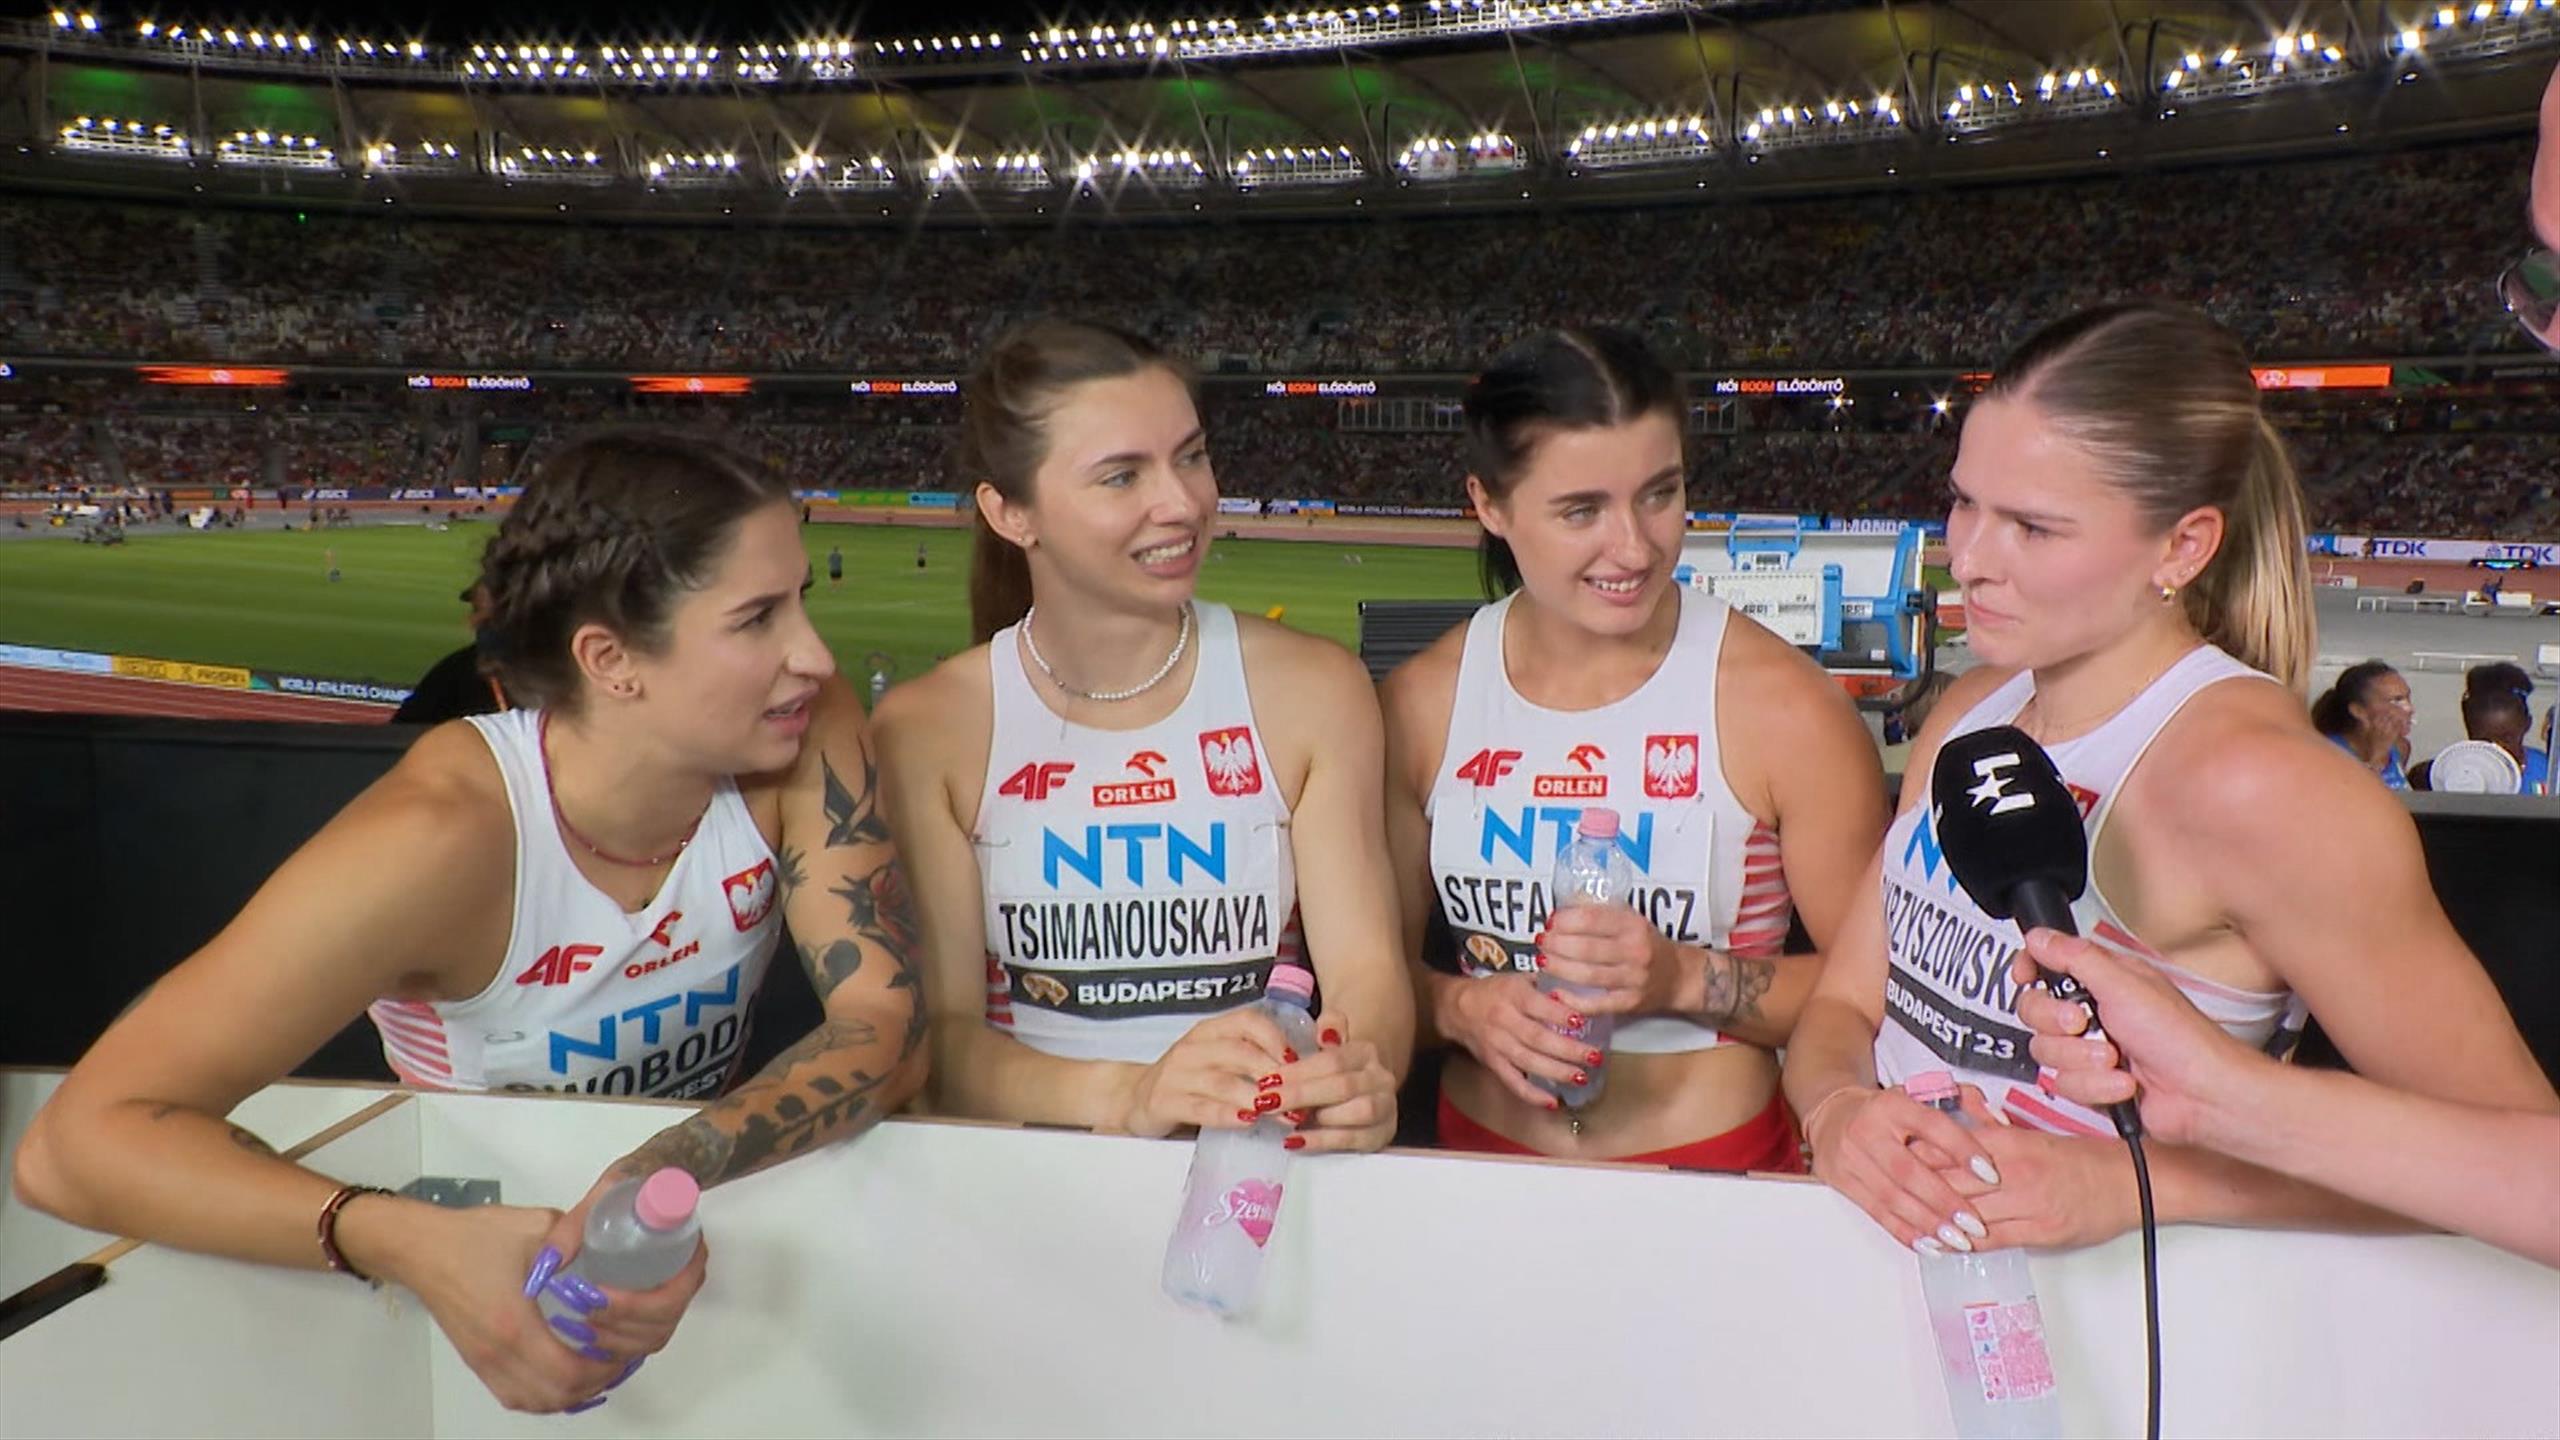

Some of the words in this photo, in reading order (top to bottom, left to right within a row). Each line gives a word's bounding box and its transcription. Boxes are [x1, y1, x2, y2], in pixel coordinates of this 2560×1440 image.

[2374, 540, 2427, 557] TDK
[2503, 545, 2553, 562] TDK
[1096, 782, 1172, 804] ORLEN
[1536, 778, 1604, 796] ORLEN
[1043, 821, 1227, 890] NTN
[1480, 805, 1654, 875] NTN
[999, 893, 1269, 960] TSIMANOUSKAYA
[1444, 874, 1699, 942] STEFAICZ
[624, 939, 700, 980] ORLEN
[1077, 978, 1228, 1005] BUDAPEST
[1886, 977, 1973, 1049] BUDAPEST
[1973, 1032, 2016, 1059] 23
[549, 964, 740, 1075] NTN
